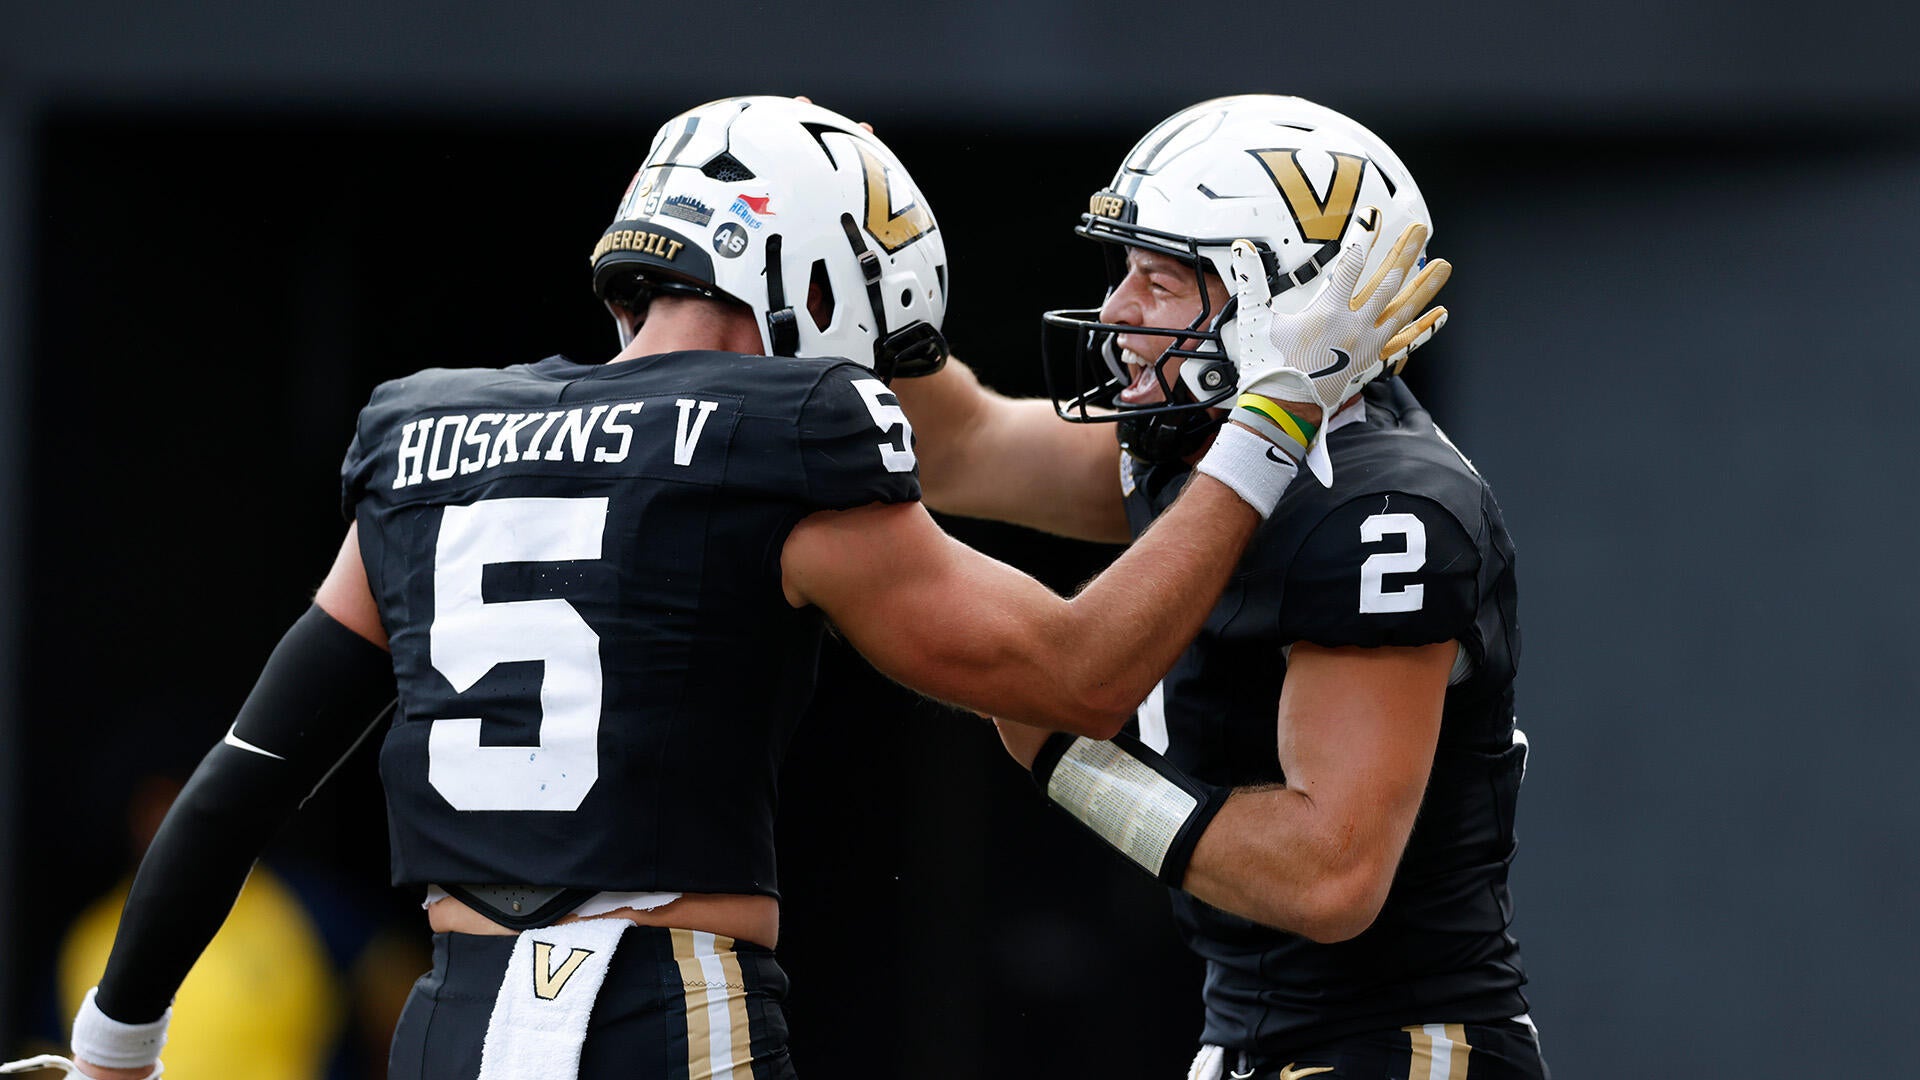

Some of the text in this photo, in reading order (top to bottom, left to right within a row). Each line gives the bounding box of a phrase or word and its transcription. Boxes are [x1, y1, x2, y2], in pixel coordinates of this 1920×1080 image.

[715, 228, 746, 253] AS
[728, 202, 763, 230] HEROES
[1245, 148, 1369, 245] V
[392, 398, 718, 489] HOSKINS V
[850, 379, 915, 473] 5
[1359, 513, 1427, 614] 2
[428, 497, 609, 811] 5
[532, 941, 595, 1001] V
